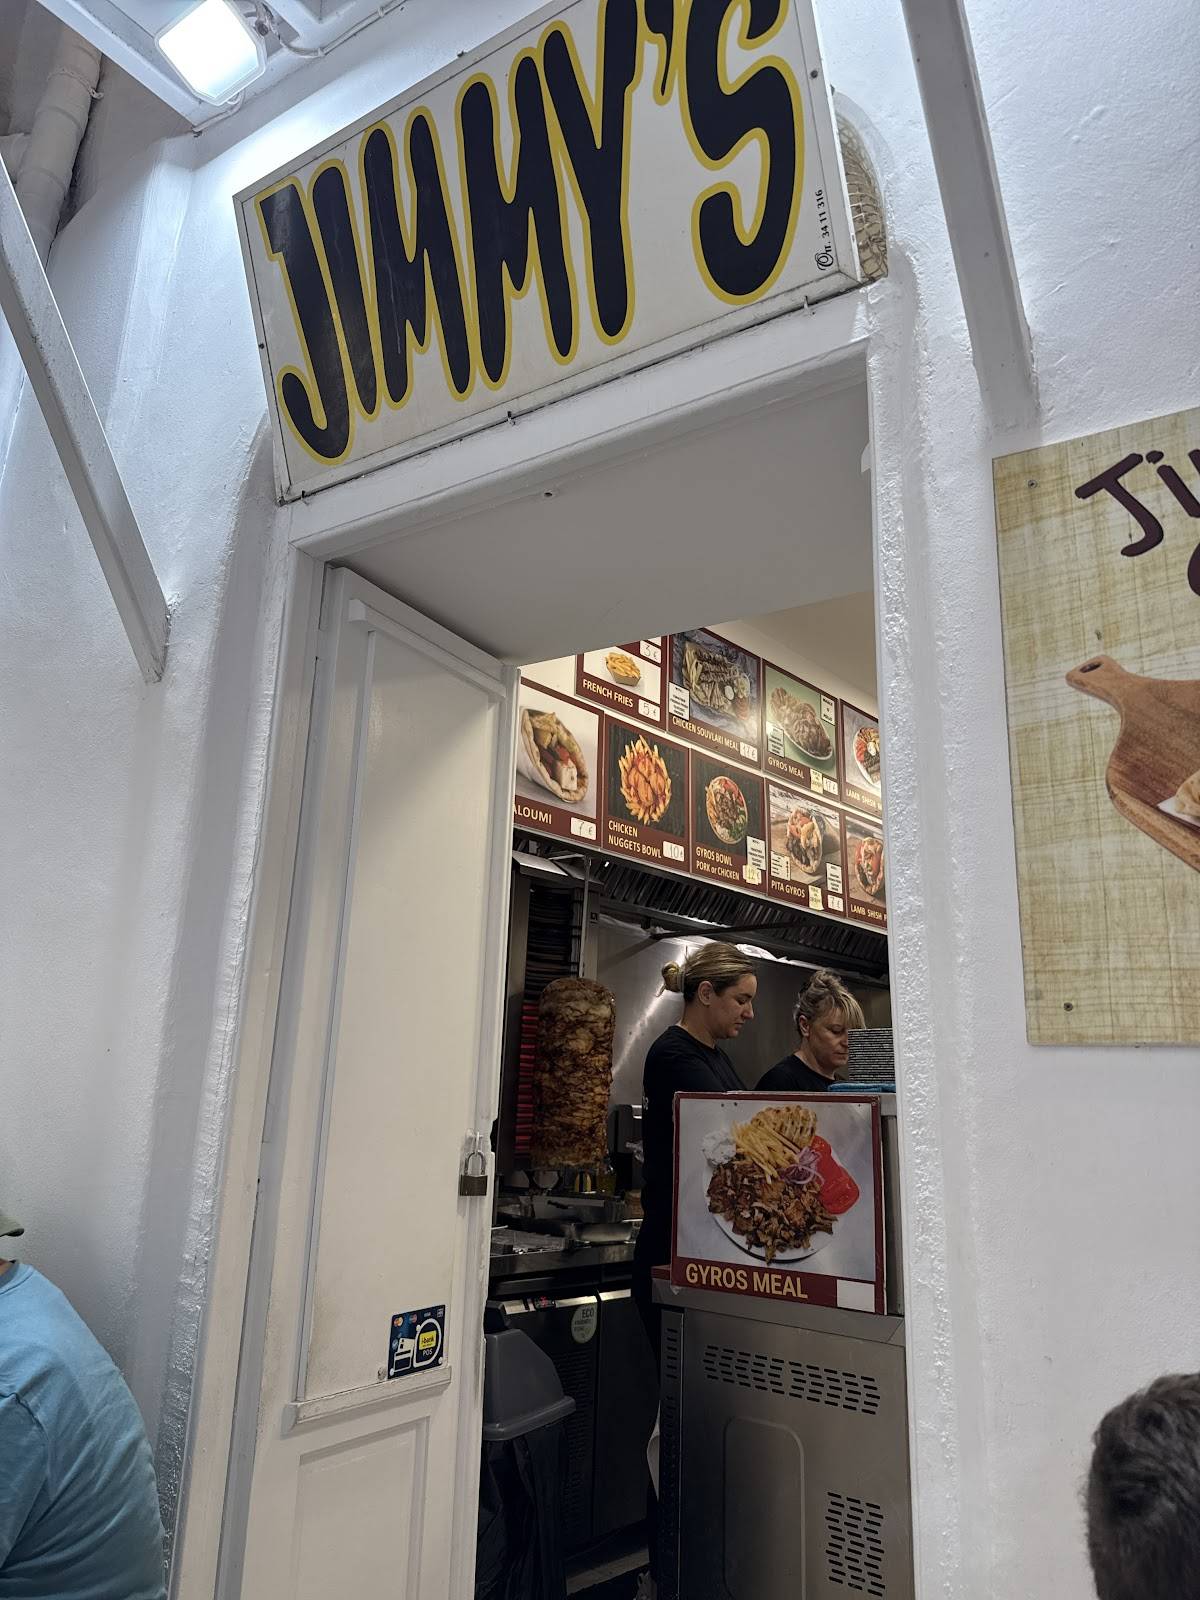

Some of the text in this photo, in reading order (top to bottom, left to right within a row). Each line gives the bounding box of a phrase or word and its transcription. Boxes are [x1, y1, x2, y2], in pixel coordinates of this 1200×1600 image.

[815, 189, 825, 209] 316
[254, 0, 805, 466] JIMMY'S
[1074, 449, 1200, 557] Ji
[582, 678, 634, 708] FRENCH FRIES
[672, 715, 740, 752] CHICKEN SOUVLAKI MEAL
[767, 756, 788, 772] GYROS
[788, 764, 805, 779] MEAL
[608, 820, 638, 838] CHICKEN
[608, 834, 662, 859] NUGGETS BOWL
[695, 846, 715, 860] GYROS
[715, 852, 733, 866] BOWL
[696, 860, 740, 881] PORK or CHICKEN
[771, 880, 785, 893] PITA
[785, 885, 806, 898] GYROS
[850, 903, 866, 916] LAMB
[867, 908, 883, 921] SHISH
[685, 1262, 809, 1300] GYROS MEAL
[422, 1348, 433, 1357] POS
